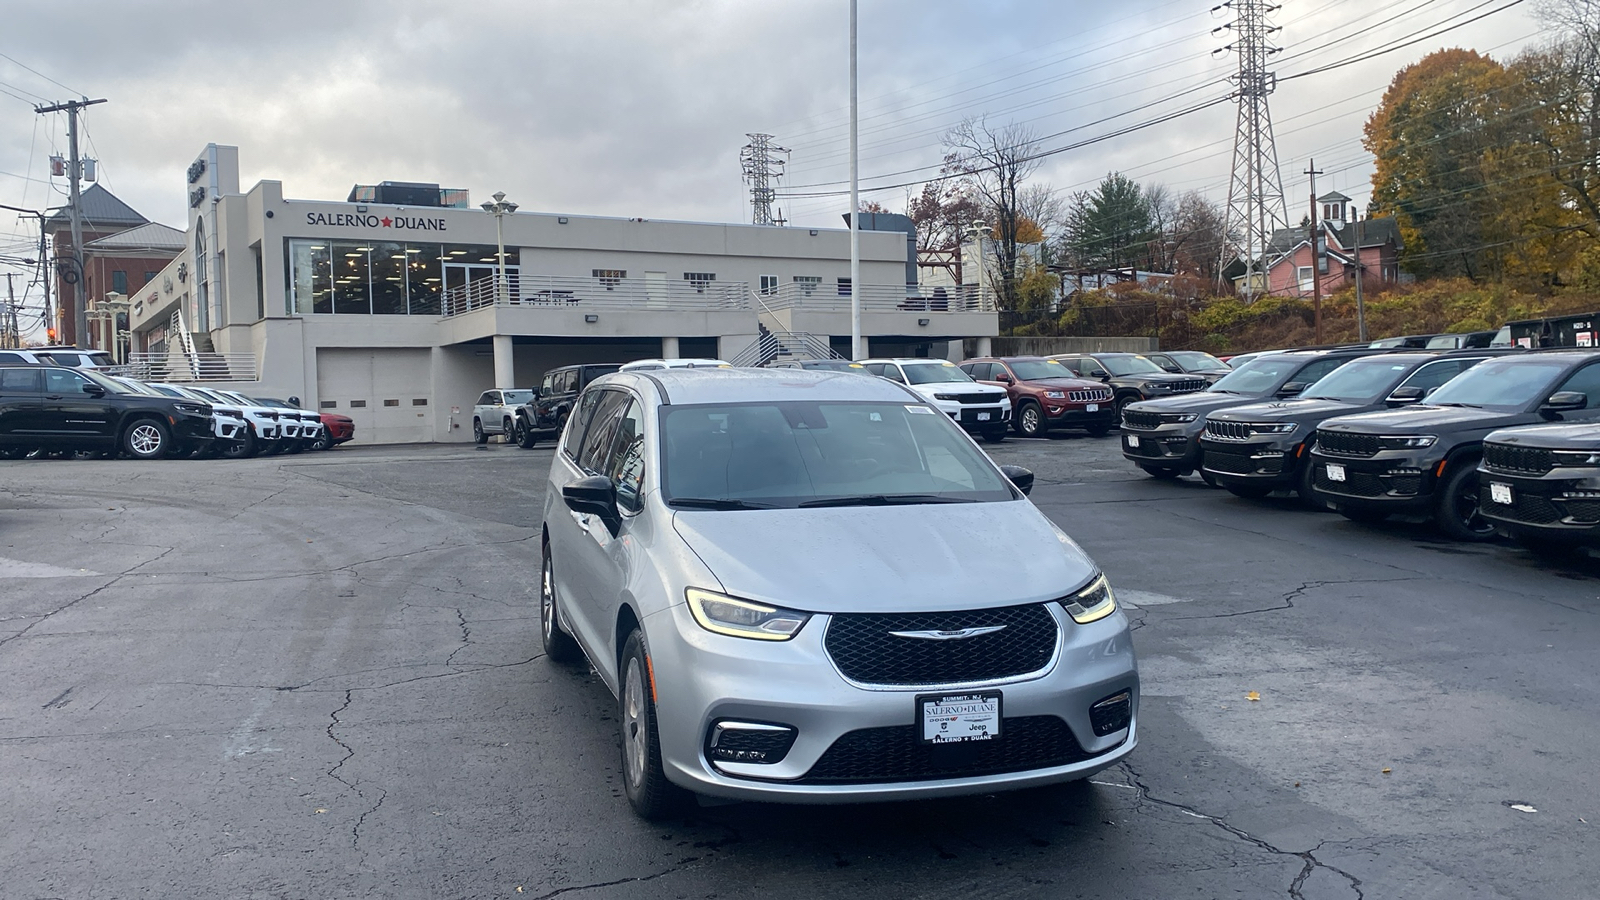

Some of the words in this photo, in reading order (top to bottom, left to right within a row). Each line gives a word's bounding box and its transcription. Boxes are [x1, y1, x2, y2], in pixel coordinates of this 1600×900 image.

[307, 212, 379, 228] SALERNO
[394, 216, 447, 231] DUANE
[926, 705, 963, 715] SALERNO
[967, 703, 996, 713] DUANE
[969, 723, 987, 731] Jeep
[932, 736, 962, 744] SALERNO
